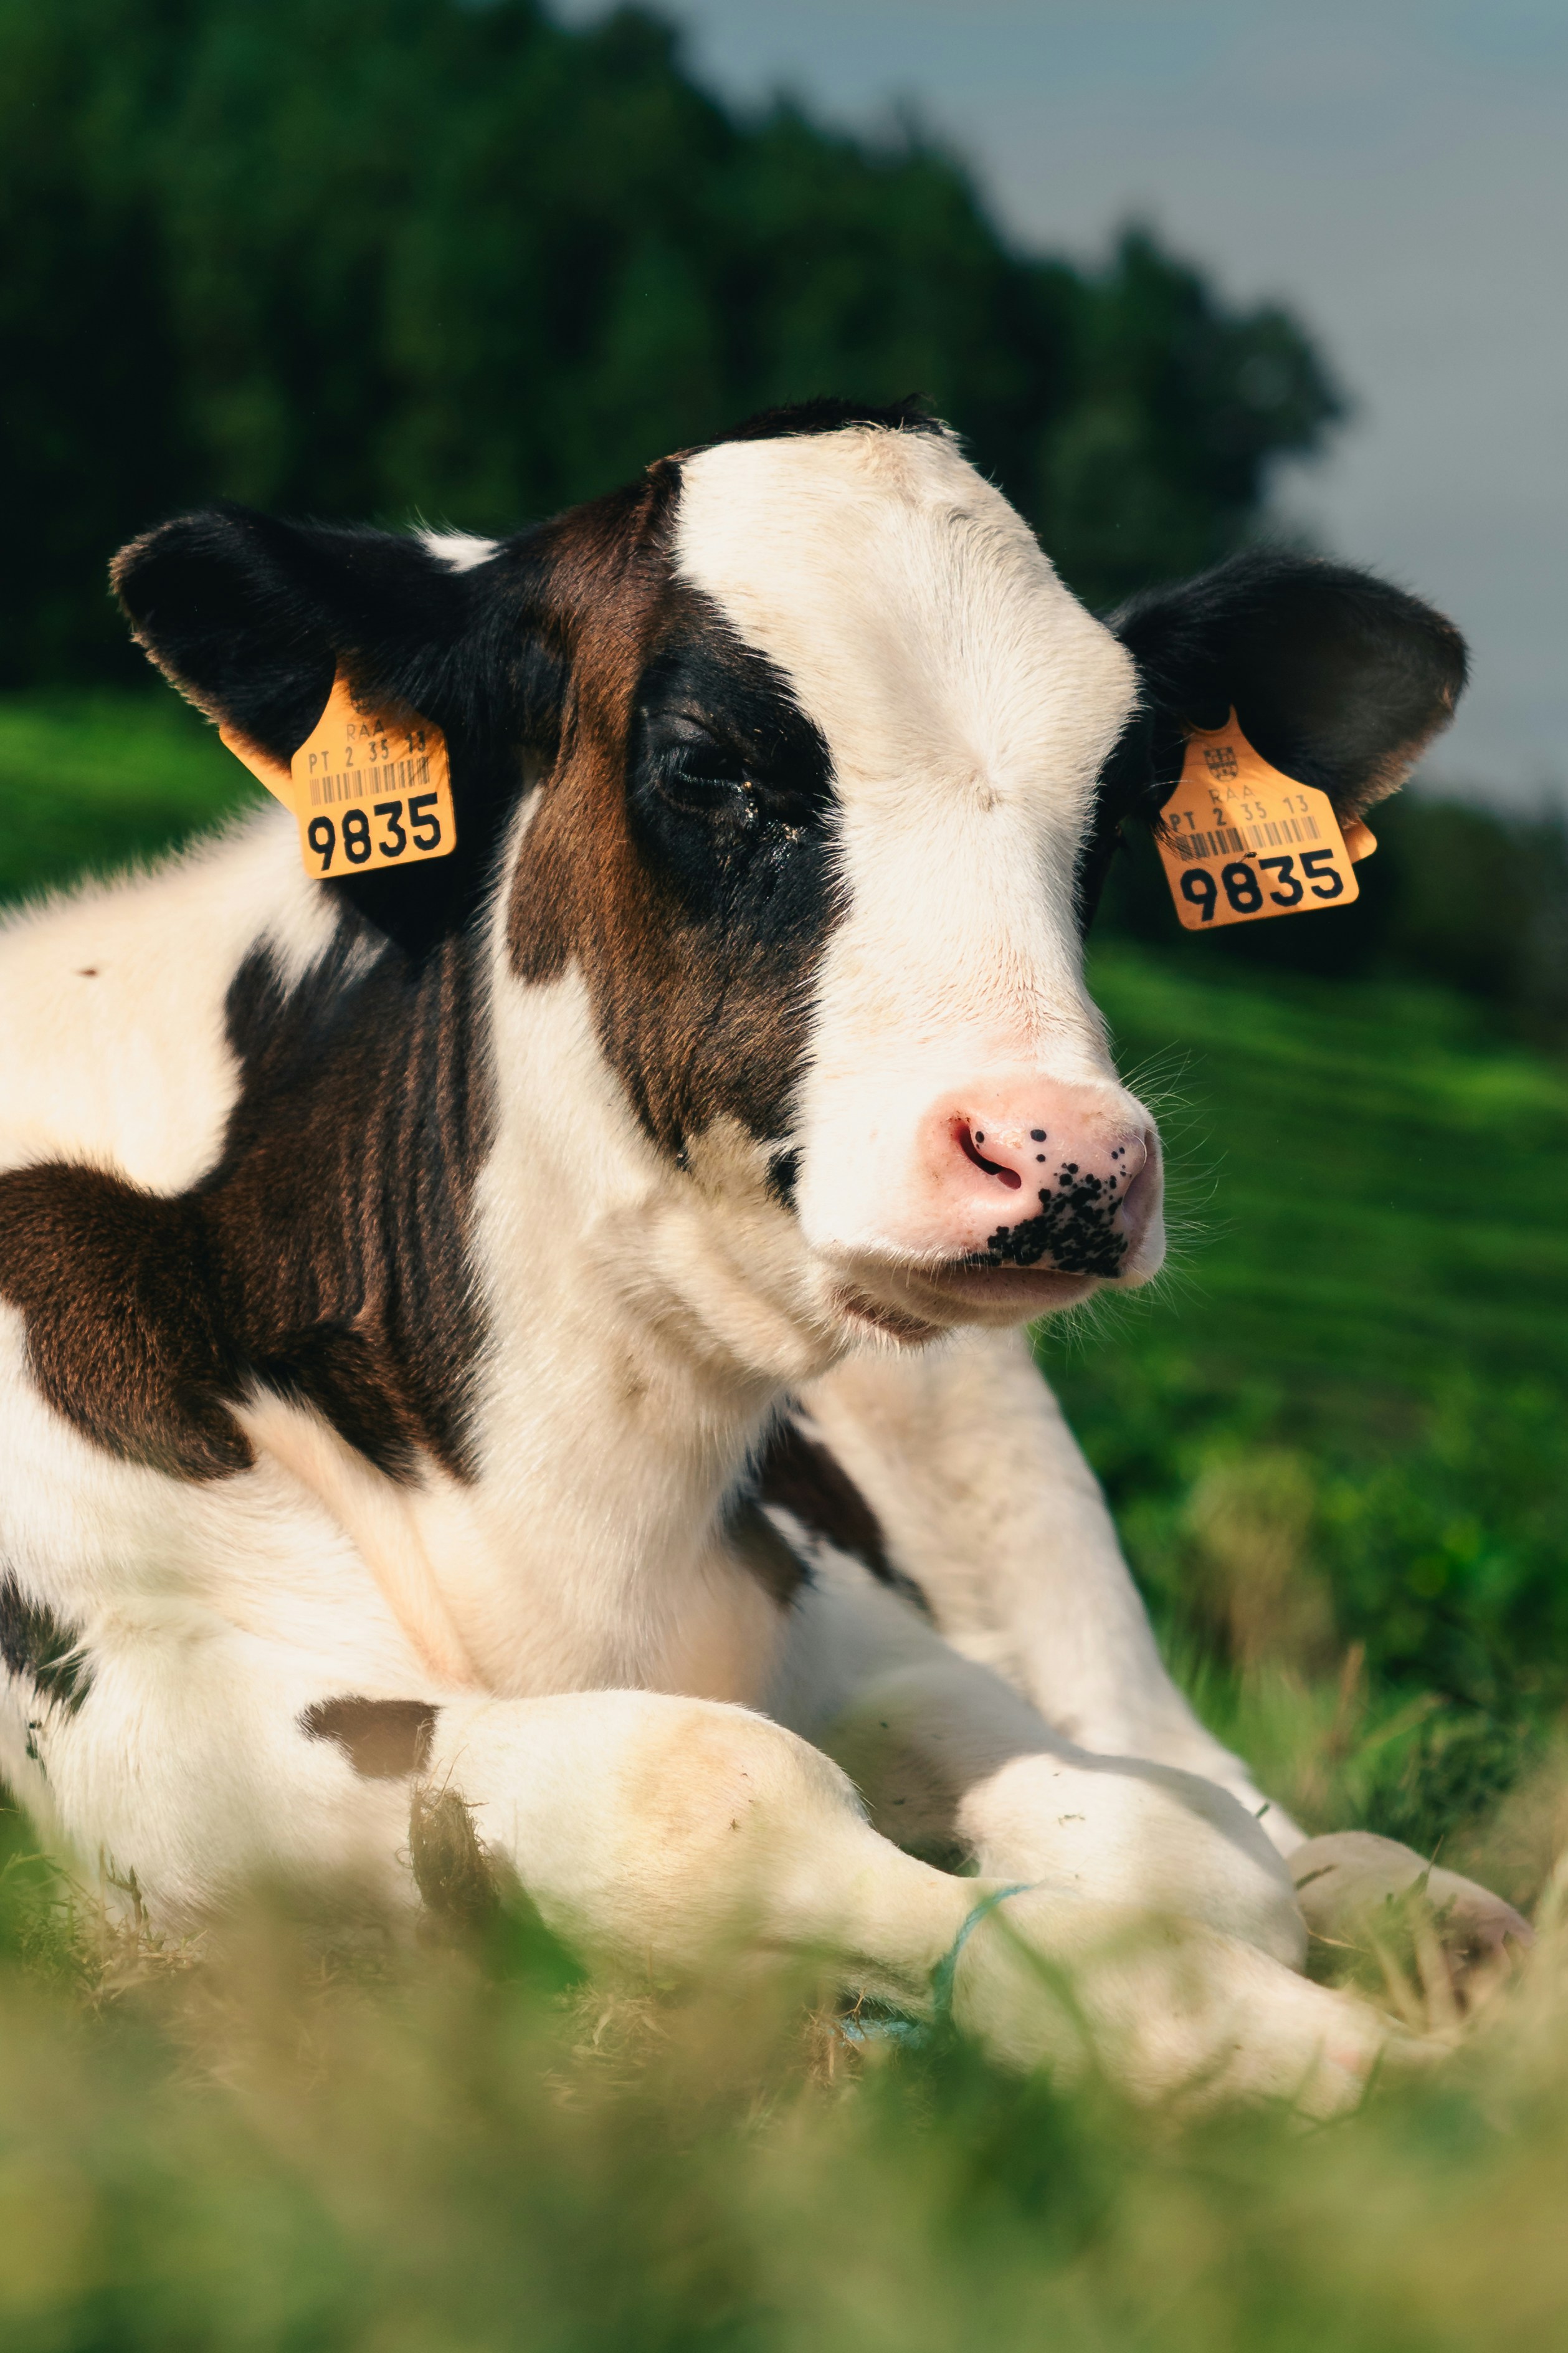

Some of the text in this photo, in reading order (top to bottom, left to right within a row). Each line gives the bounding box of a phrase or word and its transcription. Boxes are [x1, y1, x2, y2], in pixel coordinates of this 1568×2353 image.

[346, 719, 386, 742] RAA
[308, 730, 426, 774] PT 2 35 13
[1169, 794, 1310, 832] PT 2 35 13
[1208, 785, 1256, 804] RAA
[307, 791, 442, 872] 9835
[1180, 848, 1344, 922] 9835
